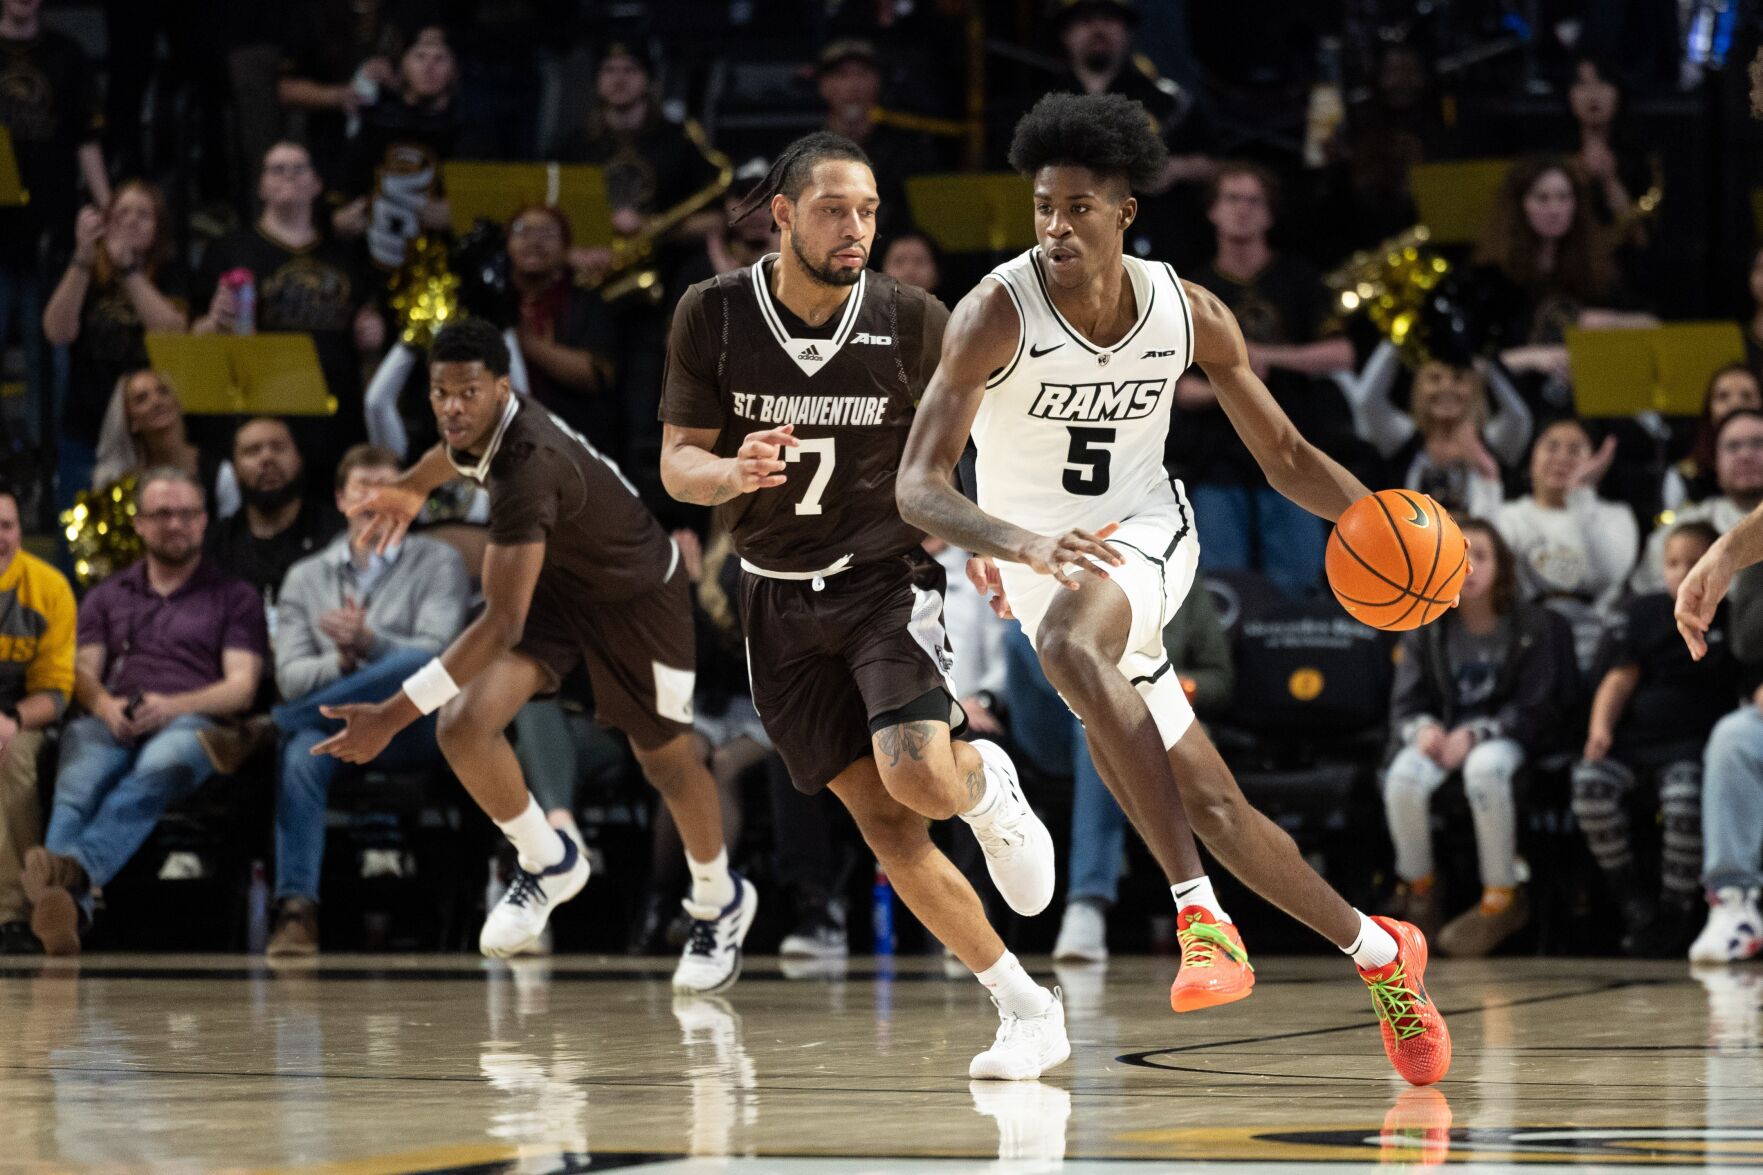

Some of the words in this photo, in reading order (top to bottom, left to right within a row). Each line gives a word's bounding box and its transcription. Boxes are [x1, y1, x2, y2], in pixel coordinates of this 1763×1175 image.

[850, 332, 892, 346] A10
[1139, 349, 1176, 360] A10
[797, 353, 823, 362] adidas
[732, 391, 757, 420] ST.
[759, 394, 889, 426] BONAVENTURE
[1028, 378, 1168, 422] RAMS
[785, 437, 836, 516] 7
[1062, 426, 1116, 496] 5
